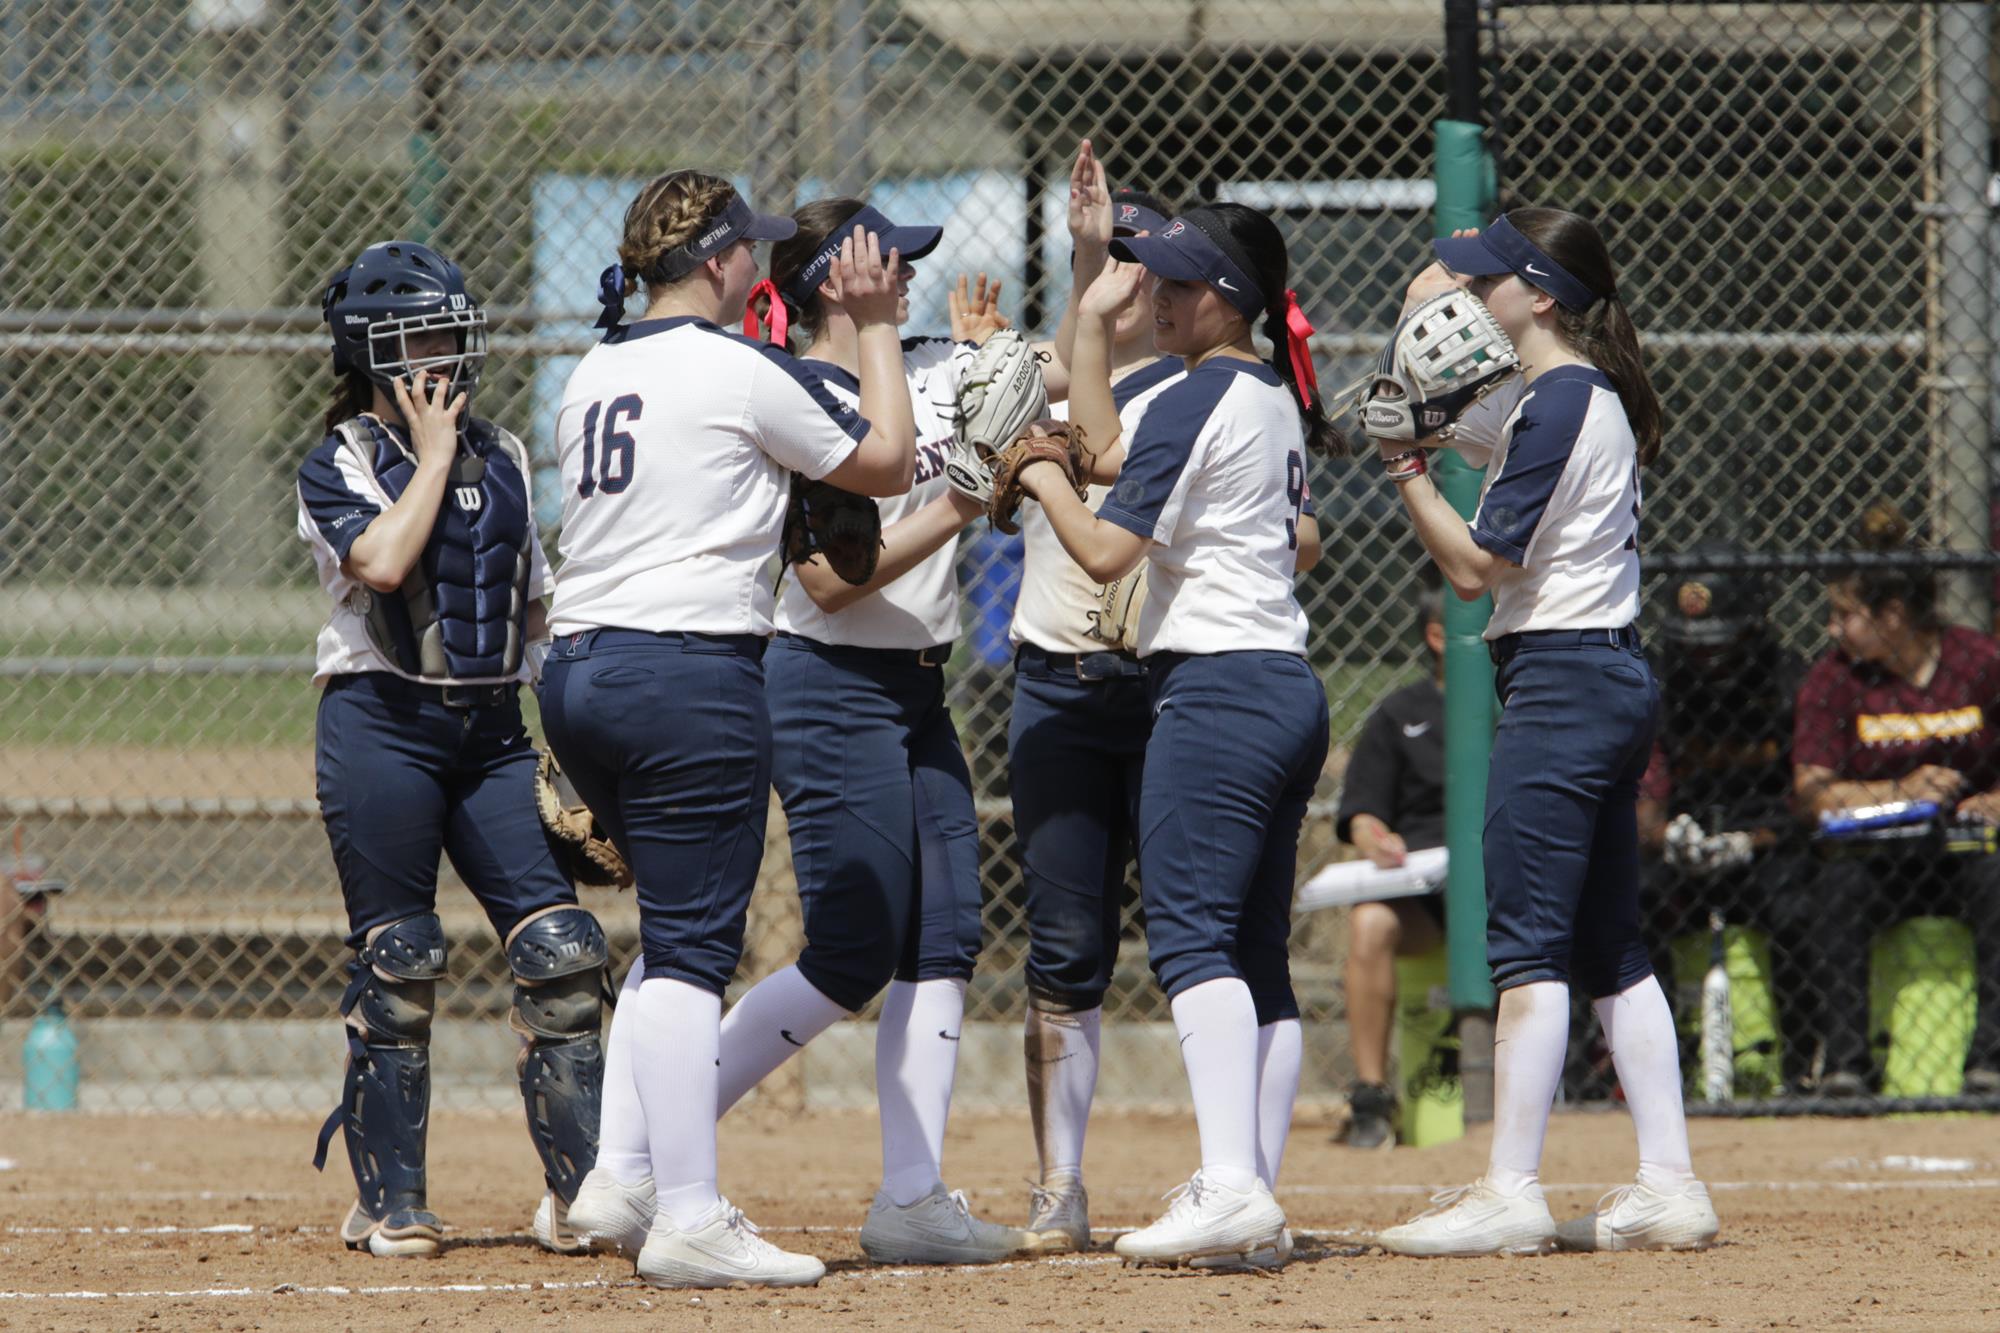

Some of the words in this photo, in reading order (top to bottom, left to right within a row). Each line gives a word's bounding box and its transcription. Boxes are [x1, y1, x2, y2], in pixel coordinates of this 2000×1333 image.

[699, 222, 731, 249] SOFTBALL
[802, 243, 842, 281] SOFTBALL
[1013, 360, 1030, 394] A2000
[577, 393, 644, 500] 16
